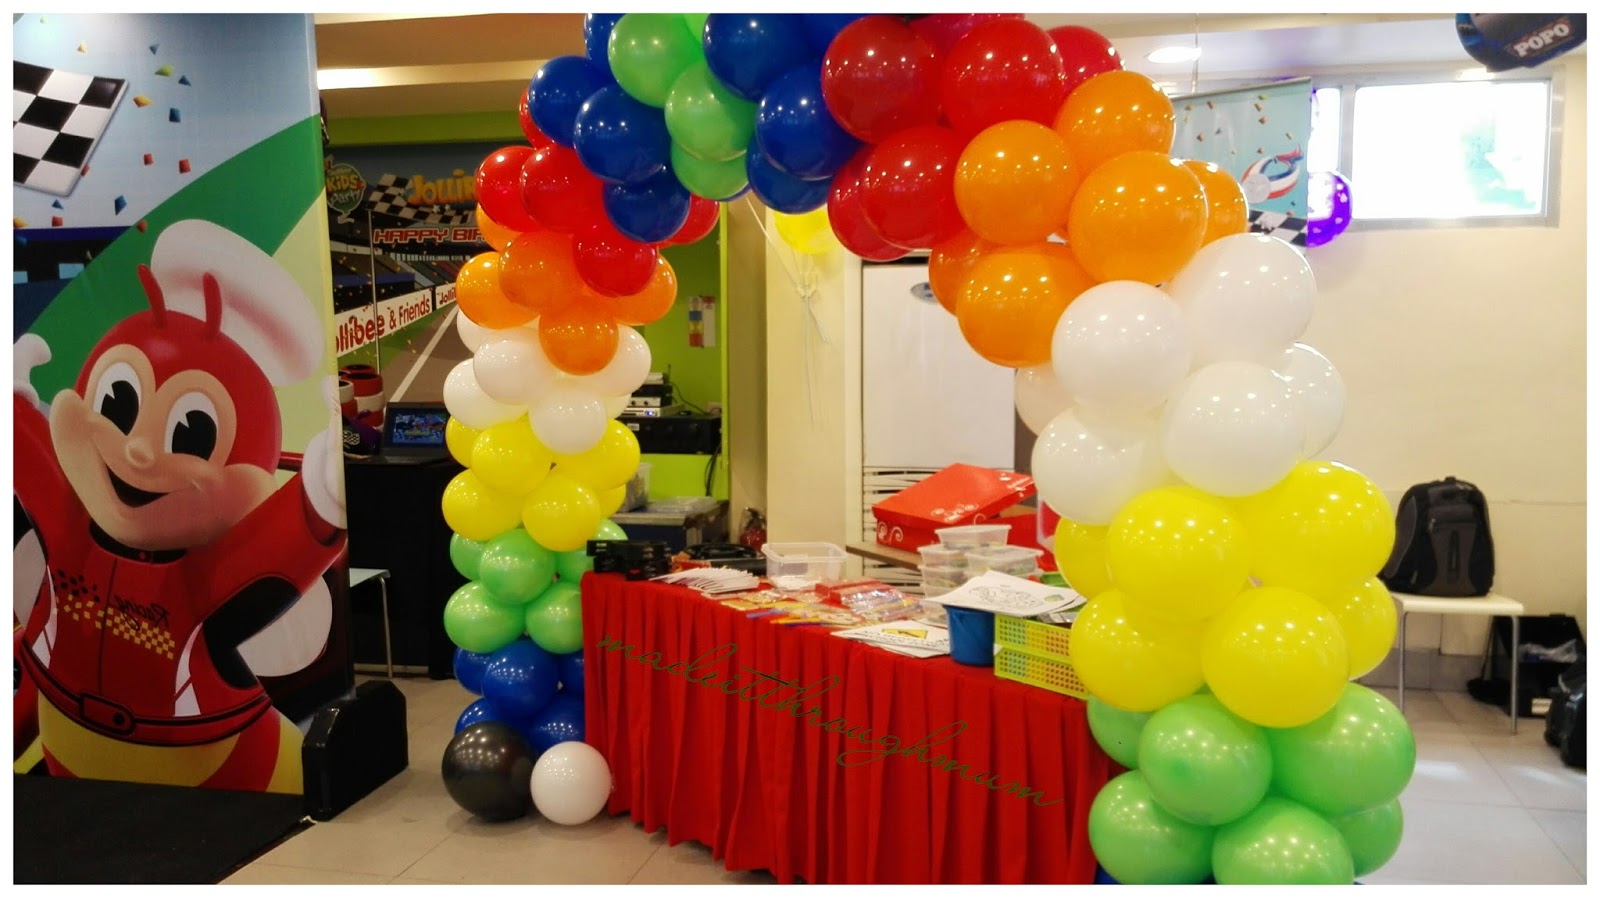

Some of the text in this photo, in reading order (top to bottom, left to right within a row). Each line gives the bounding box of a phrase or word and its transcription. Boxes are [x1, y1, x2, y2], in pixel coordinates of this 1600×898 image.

[1513, 24, 1570, 57] POPO
[374, 228, 448, 243] HAPPY
[389, 310, 397, 330] &
[399, 294, 430, 326] Friends
